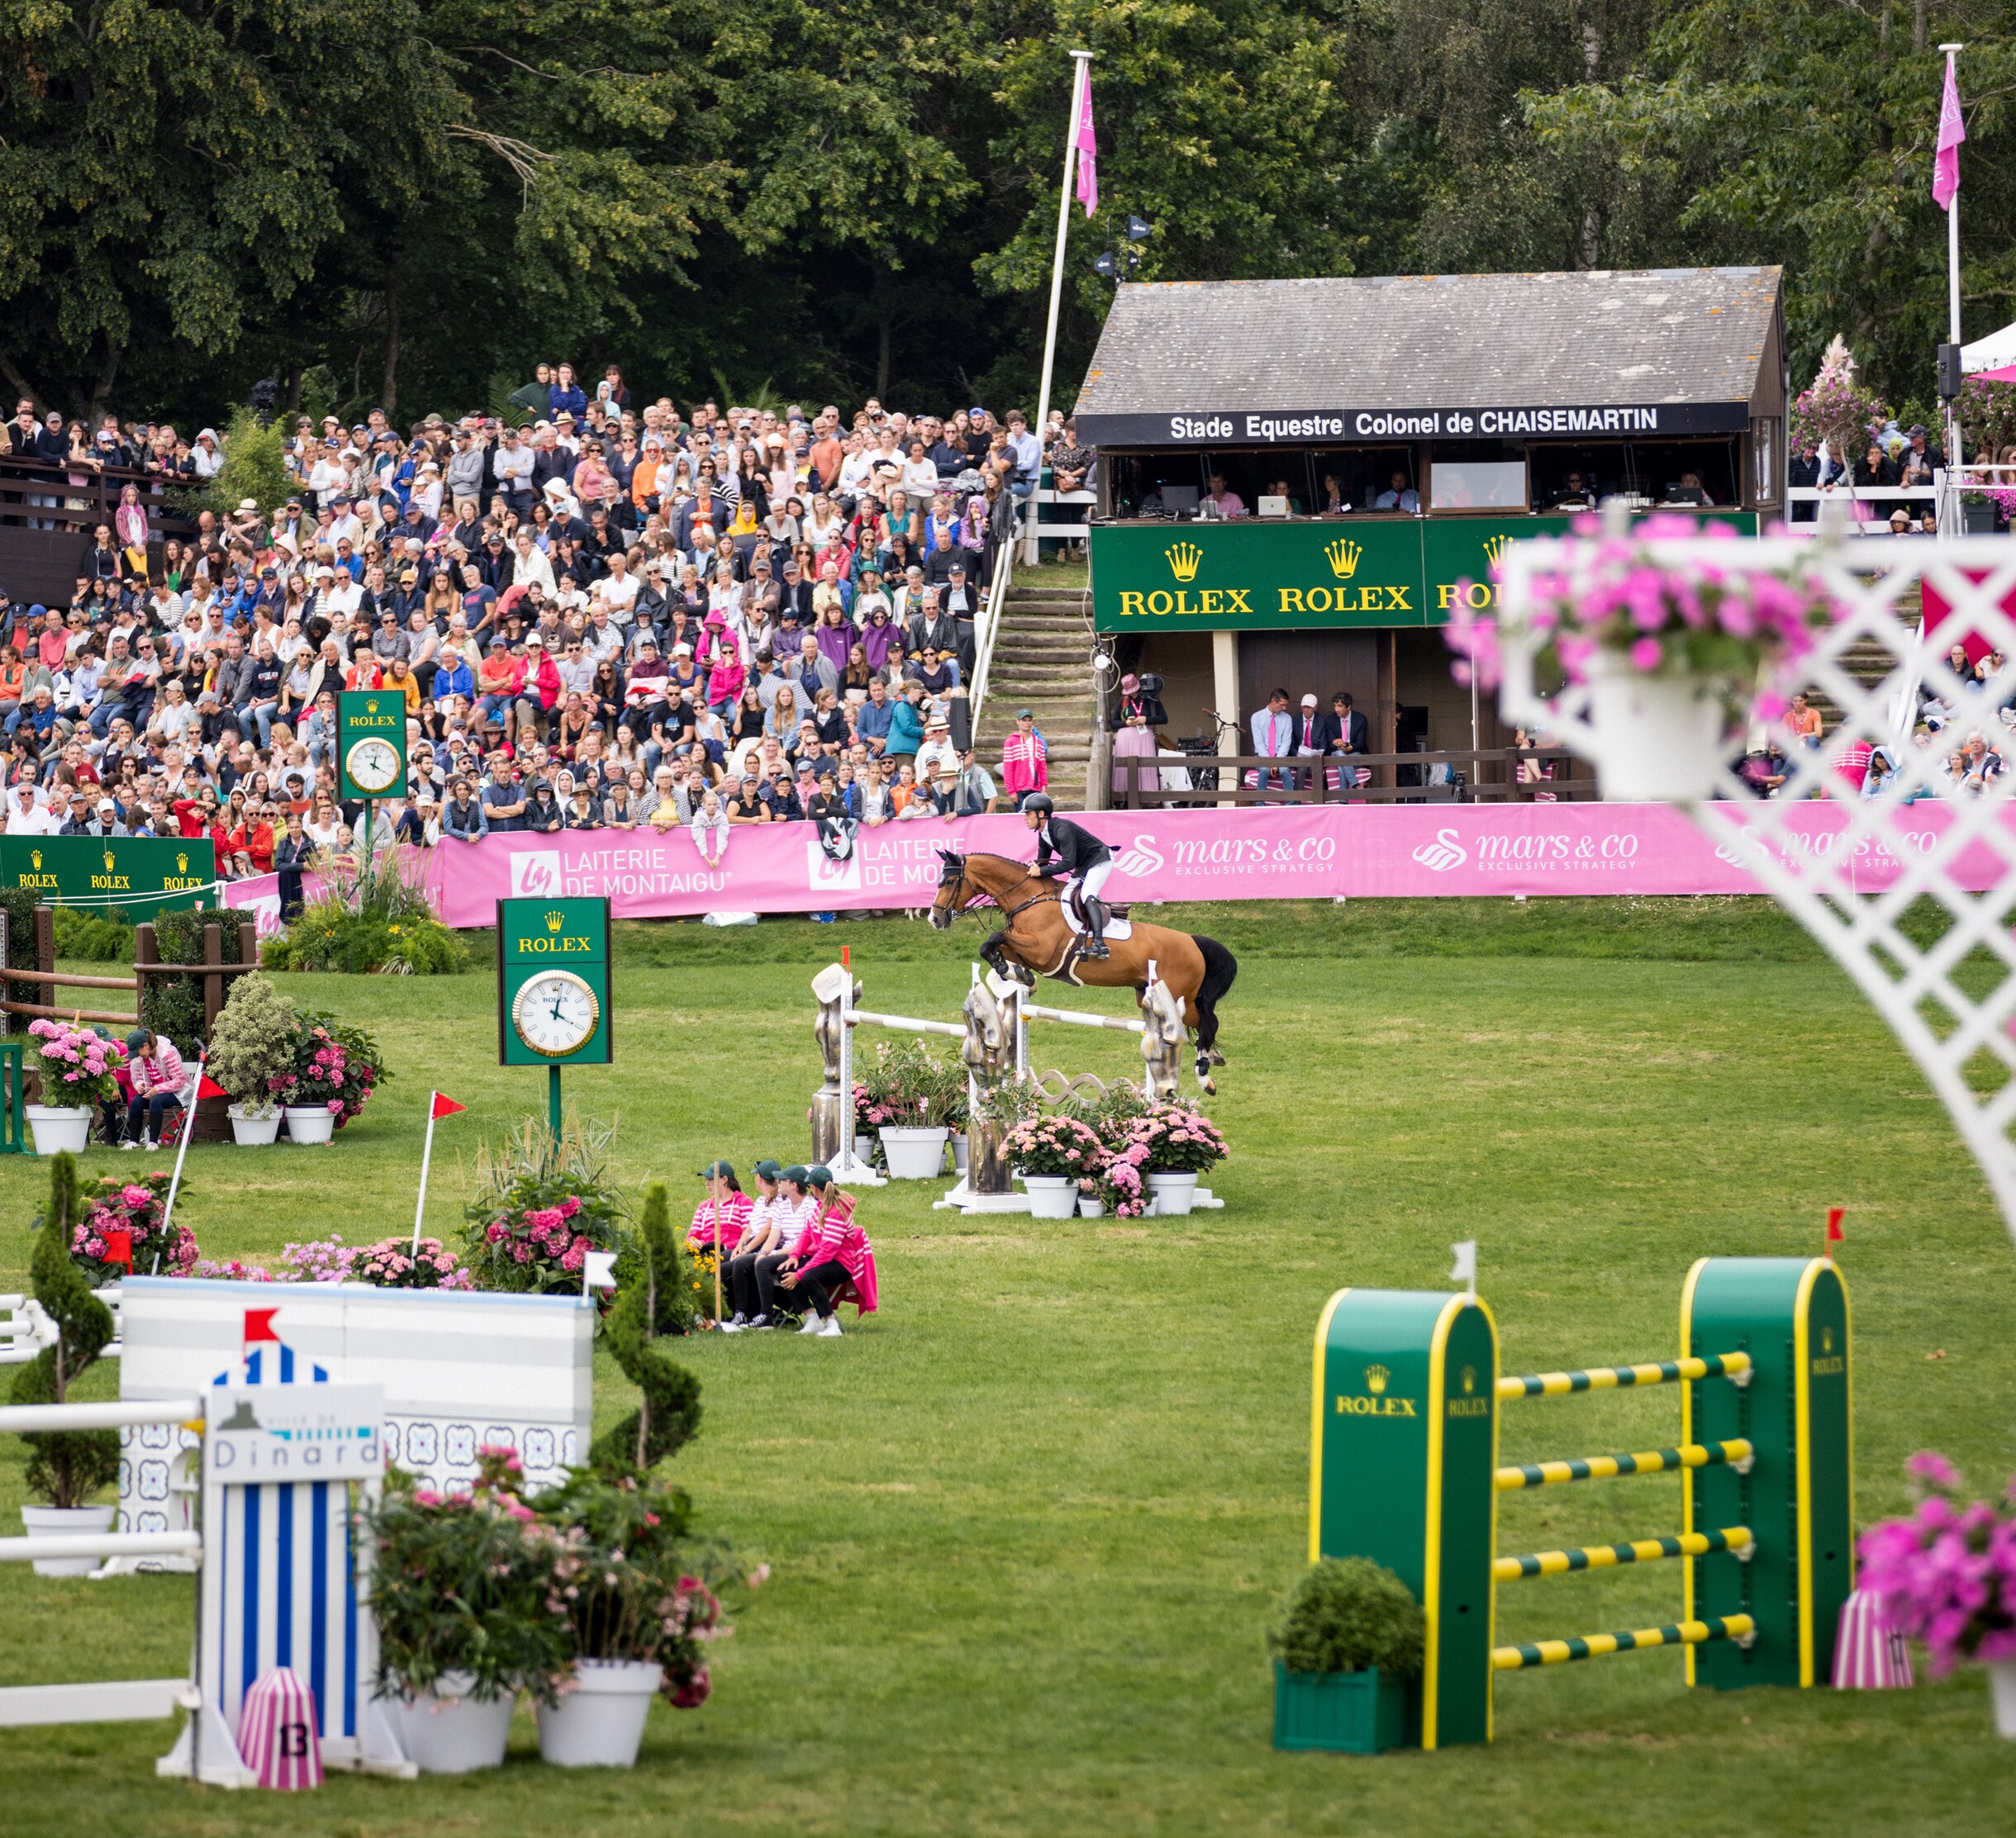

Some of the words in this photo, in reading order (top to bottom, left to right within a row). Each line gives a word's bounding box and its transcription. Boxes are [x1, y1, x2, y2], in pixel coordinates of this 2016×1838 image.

[1170, 416, 1234, 439] Stade
[1246, 416, 1343, 442] Equestre
[1356, 413, 1439, 435] Colonel
[1446, 412, 1474, 434] de
[1480, 408, 1657, 433] CHAISEMARTIN
[1120, 589, 1253, 615] ROLEX
[1278, 586, 1413, 612] ROLEX
[349, 715, 396, 726] ROLEX
[1172, 837, 1267, 864] mars
[1272, 838, 1293, 862] &
[1298, 836, 1336, 862] co
[1475, 834, 1571, 859] mars
[1574, 835, 1595, 858] &
[1600, 834, 1639, 858] co
[564, 848, 667, 872] LAITERIE
[1176, 864, 1254, 876] EXCLUSIVE
[1262, 863, 1334, 874] STRATEGY
[1478, 861, 1557, 871] EXCLUSIVE
[1564, 860, 1637, 870] STRATEGY
[19, 873, 59, 888] ROLEX
[91, 875, 131, 890] ROLEX
[164, 876, 203, 891] ROLEX
[566, 876, 597, 896] DE
[865, 867, 896, 886] DE
[519, 937, 592, 952] ROLEX
[1335, 1395, 1417, 1418] ROLEX
[1448, 1398, 1487, 1418] ROLEX
[214, 1426, 378, 1470] Dinard
[280, 1722, 307, 1757] 13
